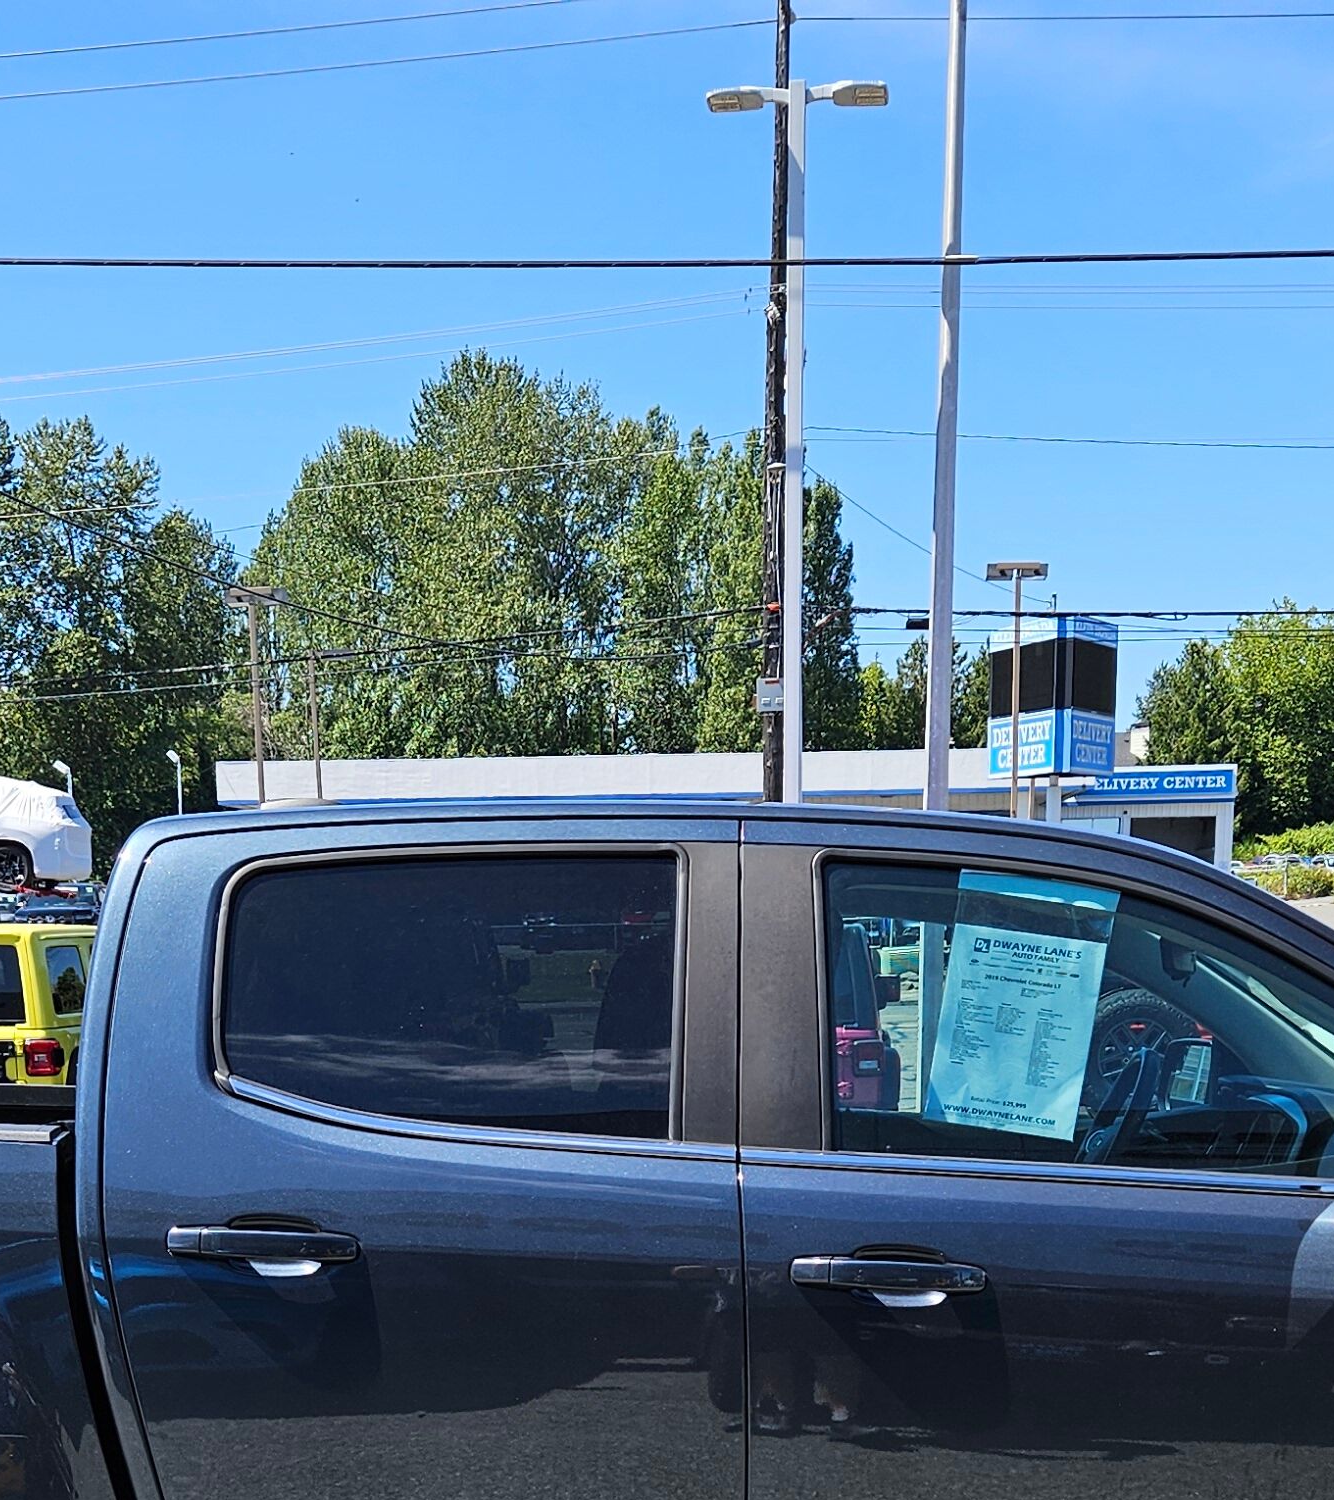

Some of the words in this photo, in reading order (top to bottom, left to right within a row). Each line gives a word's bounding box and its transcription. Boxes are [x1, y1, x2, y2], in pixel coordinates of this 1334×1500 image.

[992, 720, 1051, 748] DELVERY
[1073, 720, 1112, 744] DELIVERY
[1075, 743, 1107, 765] CENTER
[1094, 778, 1159, 791] ELIVERY
[1163, 775, 1227, 789] CENTER
[992, 939, 1043, 954] DWAYNE
[1043, 946, 1082, 959] LANE'S
[1011, 951, 1034, 960] AUTO
[1034, 954, 1060, 964] FAMILY
[943, 1104, 1056, 1126] WWW.DWAYNELANE.COM
